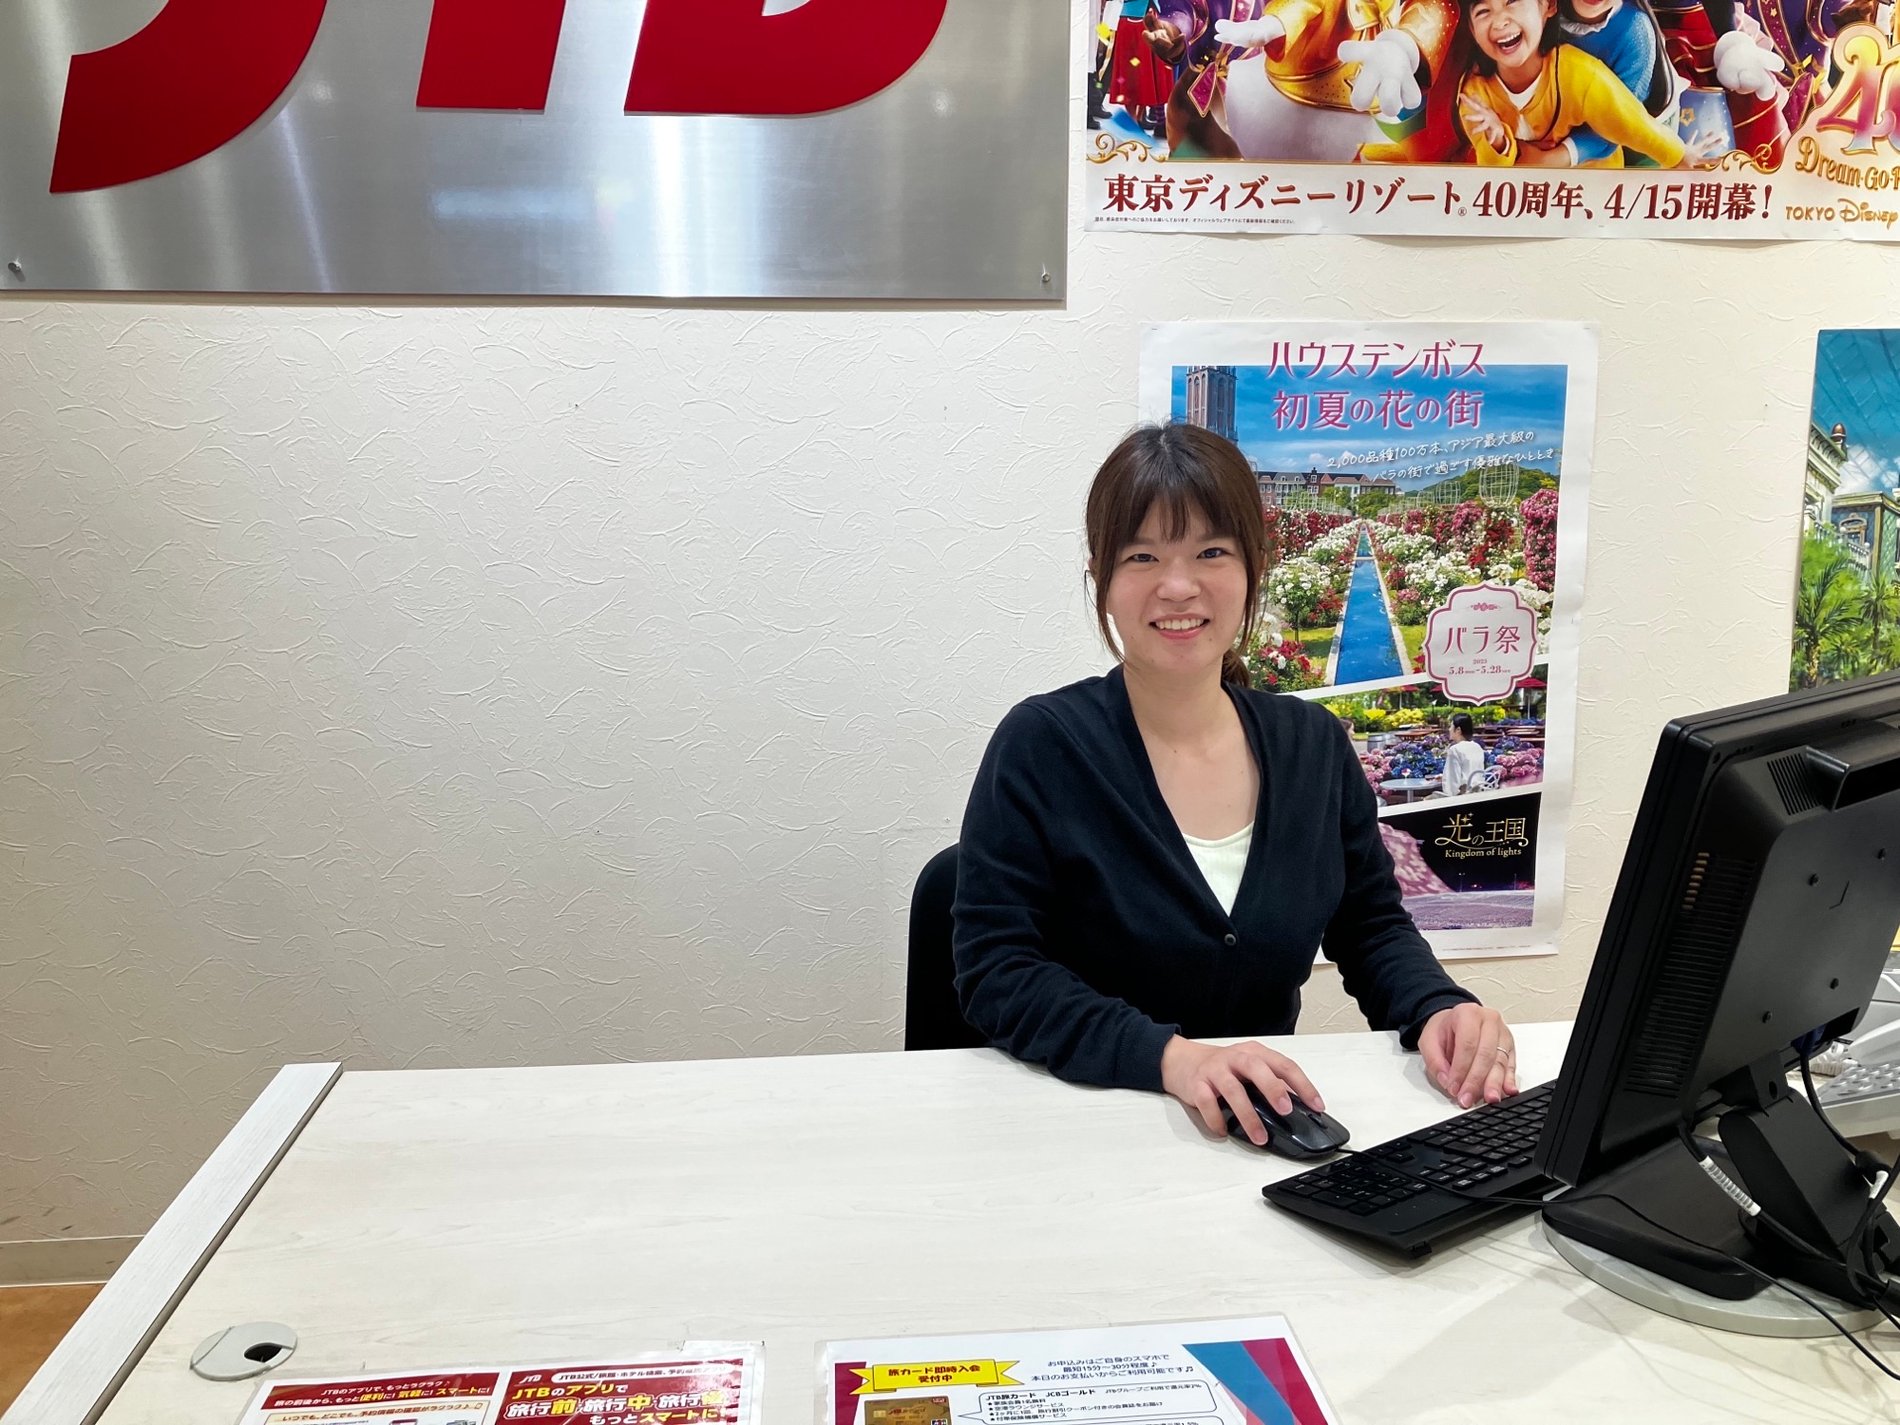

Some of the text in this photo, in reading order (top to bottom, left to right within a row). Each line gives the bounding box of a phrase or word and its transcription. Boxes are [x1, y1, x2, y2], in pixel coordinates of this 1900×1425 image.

[1785, 206, 1836, 221] TOKYO
[1266, 339, 1486, 378] ハウステンボス
[1272, 389, 1483, 431] 初夏の花の街
[1373, 448, 1554, 480] バラの街で過ごす優雅なひととき
[1443, 625, 1521, 654] バラ祭
[1436, 813, 1529, 849] 光の王国
[1445, 847, 1522, 859] Kingdom of lights
[518, 1374, 542, 1384] JTB
[888, 1364, 981, 1377] 旅カード即時入会
[918, 1375, 953, 1383] 受付中
[512, 1383, 629, 1400] JTBのアプリで
